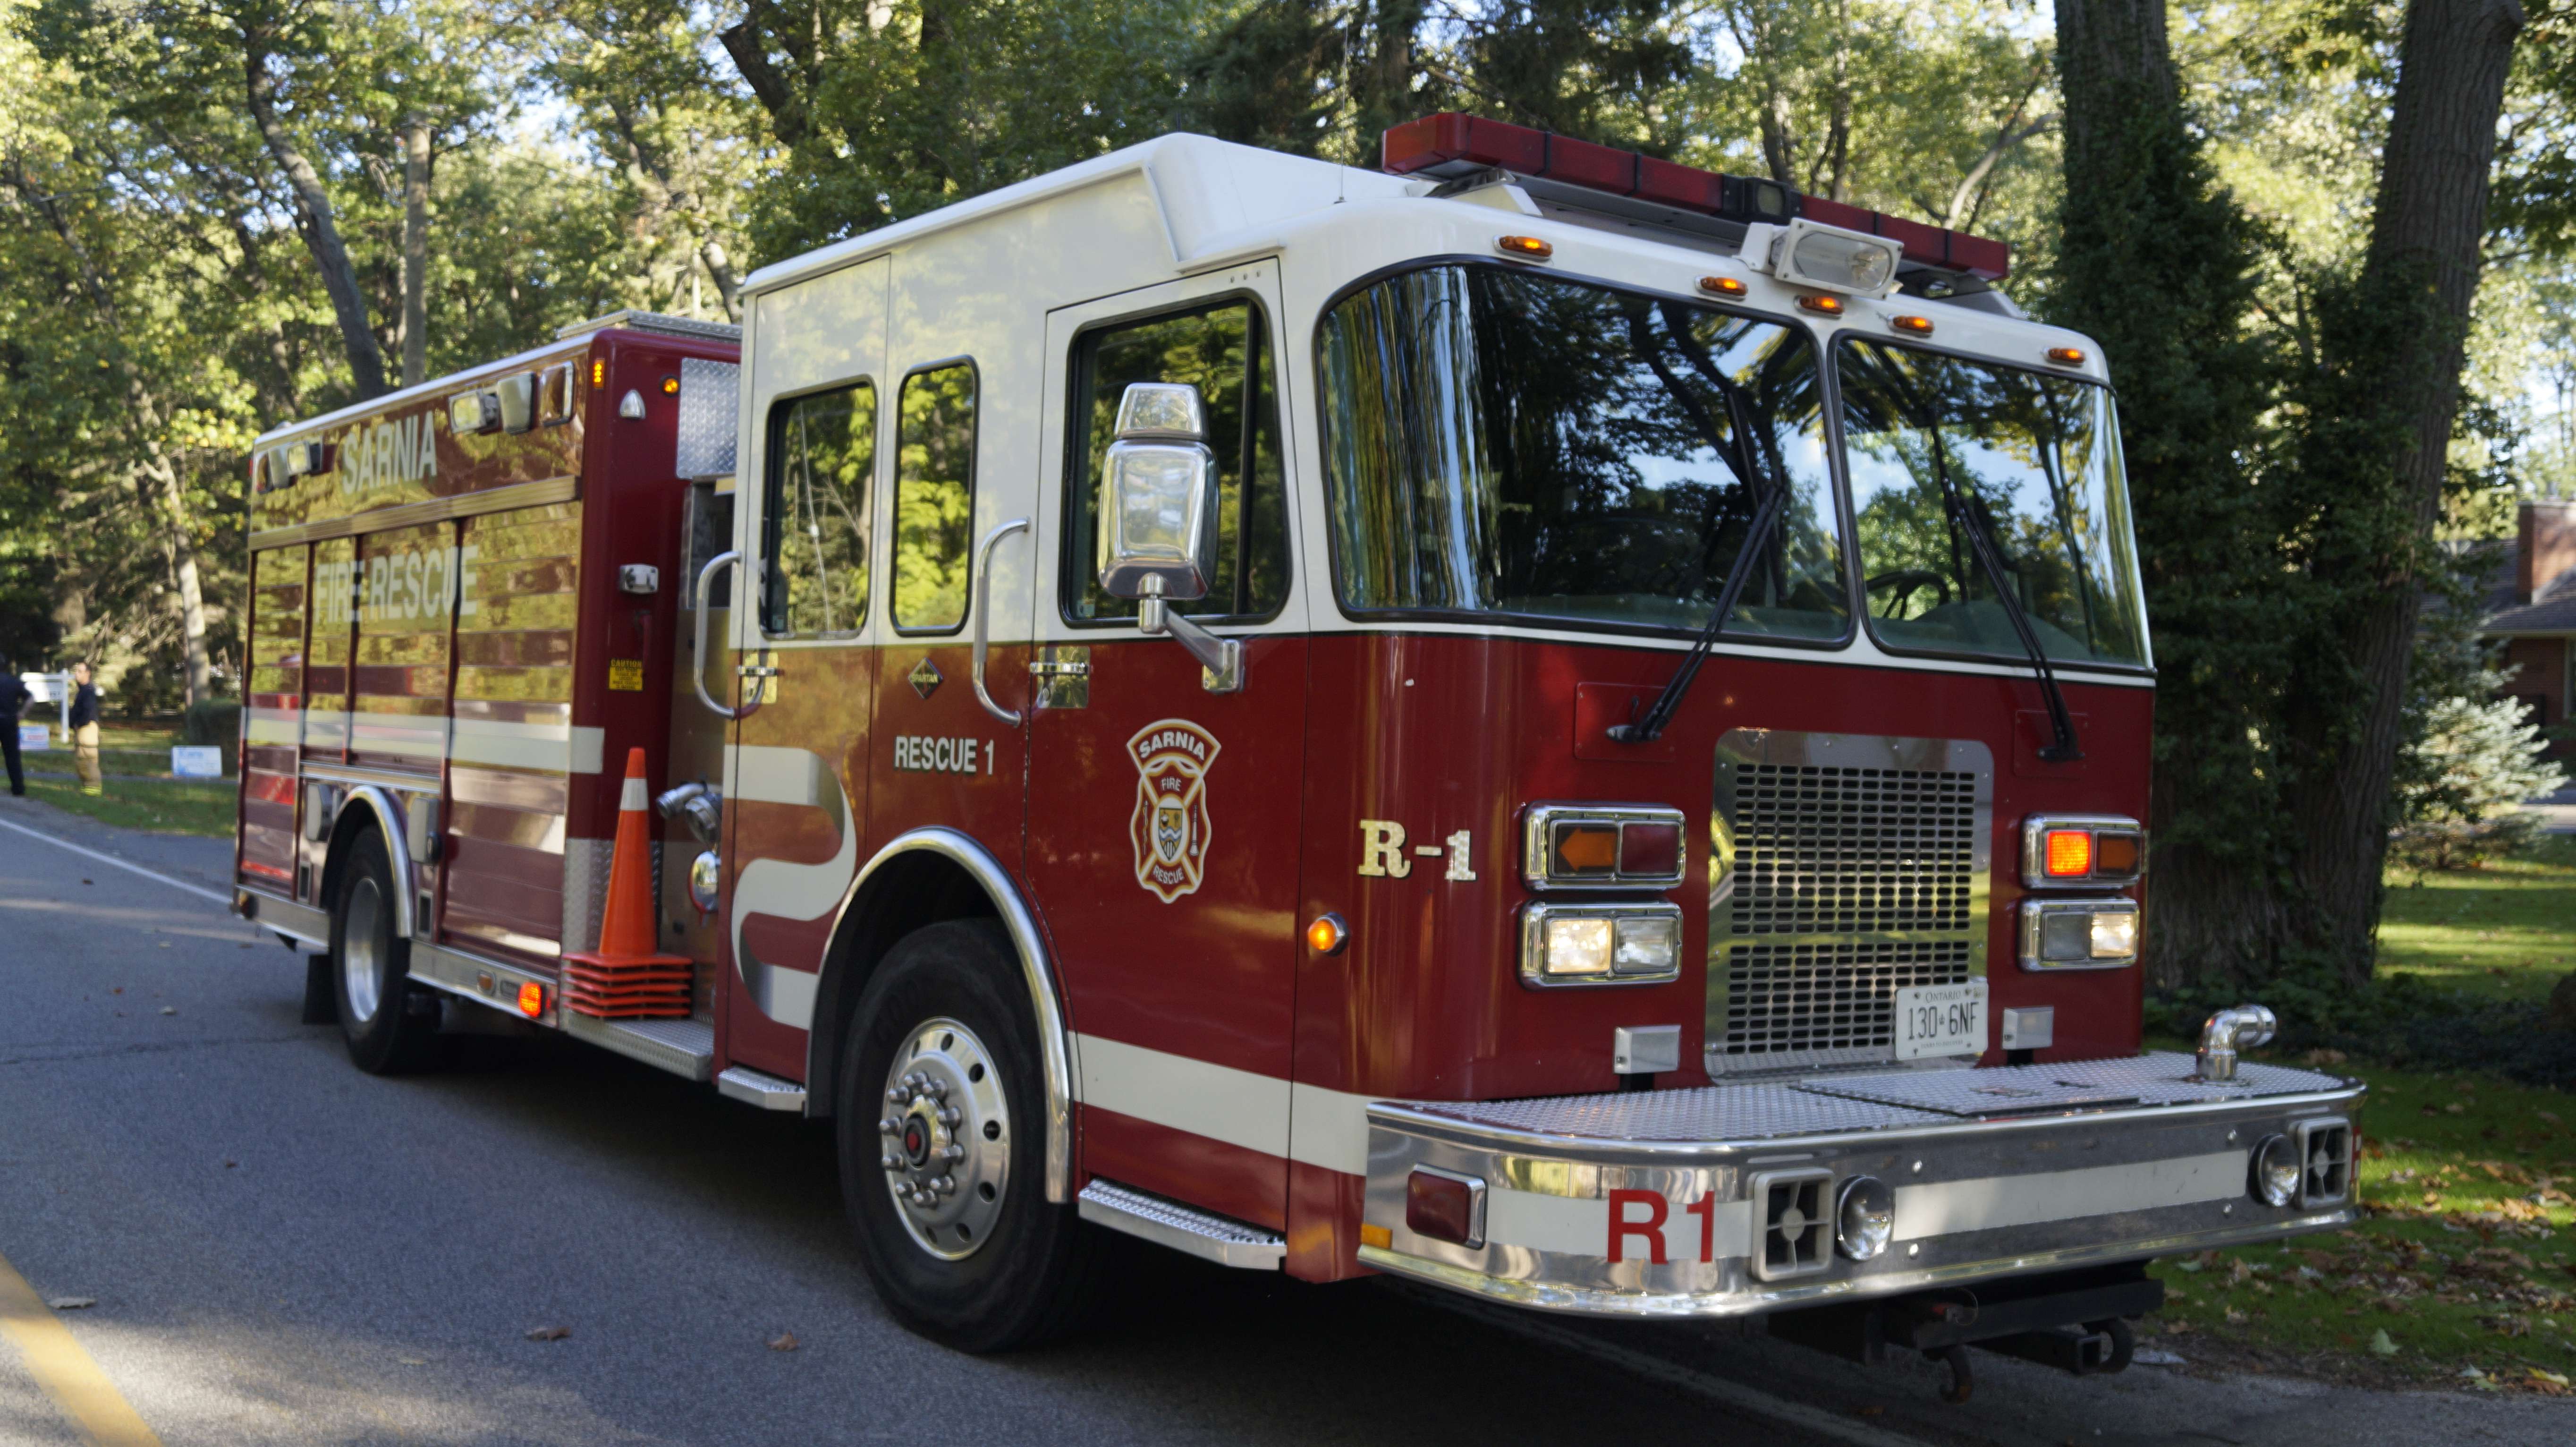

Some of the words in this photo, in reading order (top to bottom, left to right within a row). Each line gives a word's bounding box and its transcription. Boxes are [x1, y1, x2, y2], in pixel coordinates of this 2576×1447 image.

[341, 410, 437, 495] SARNIA
[315, 560, 364, 623] FIRE
[370, 545, 478, 620] RESCUE
[611, 659, 642, 667] CAUTION
[911, 673, 938, 683] SPARTAN
[894, 736, 977, 773] RESCUE
[985, 740, 994, 775] 1
[1139, 731, 1205, 760] SARNIA
[1161, 776, 1181, 792] FIRE
[1358, 819, 1476, 881] R-1
[1153, 865, 1185, 885] RESCUE
[1608, 1189, 1715, 1265] R1
